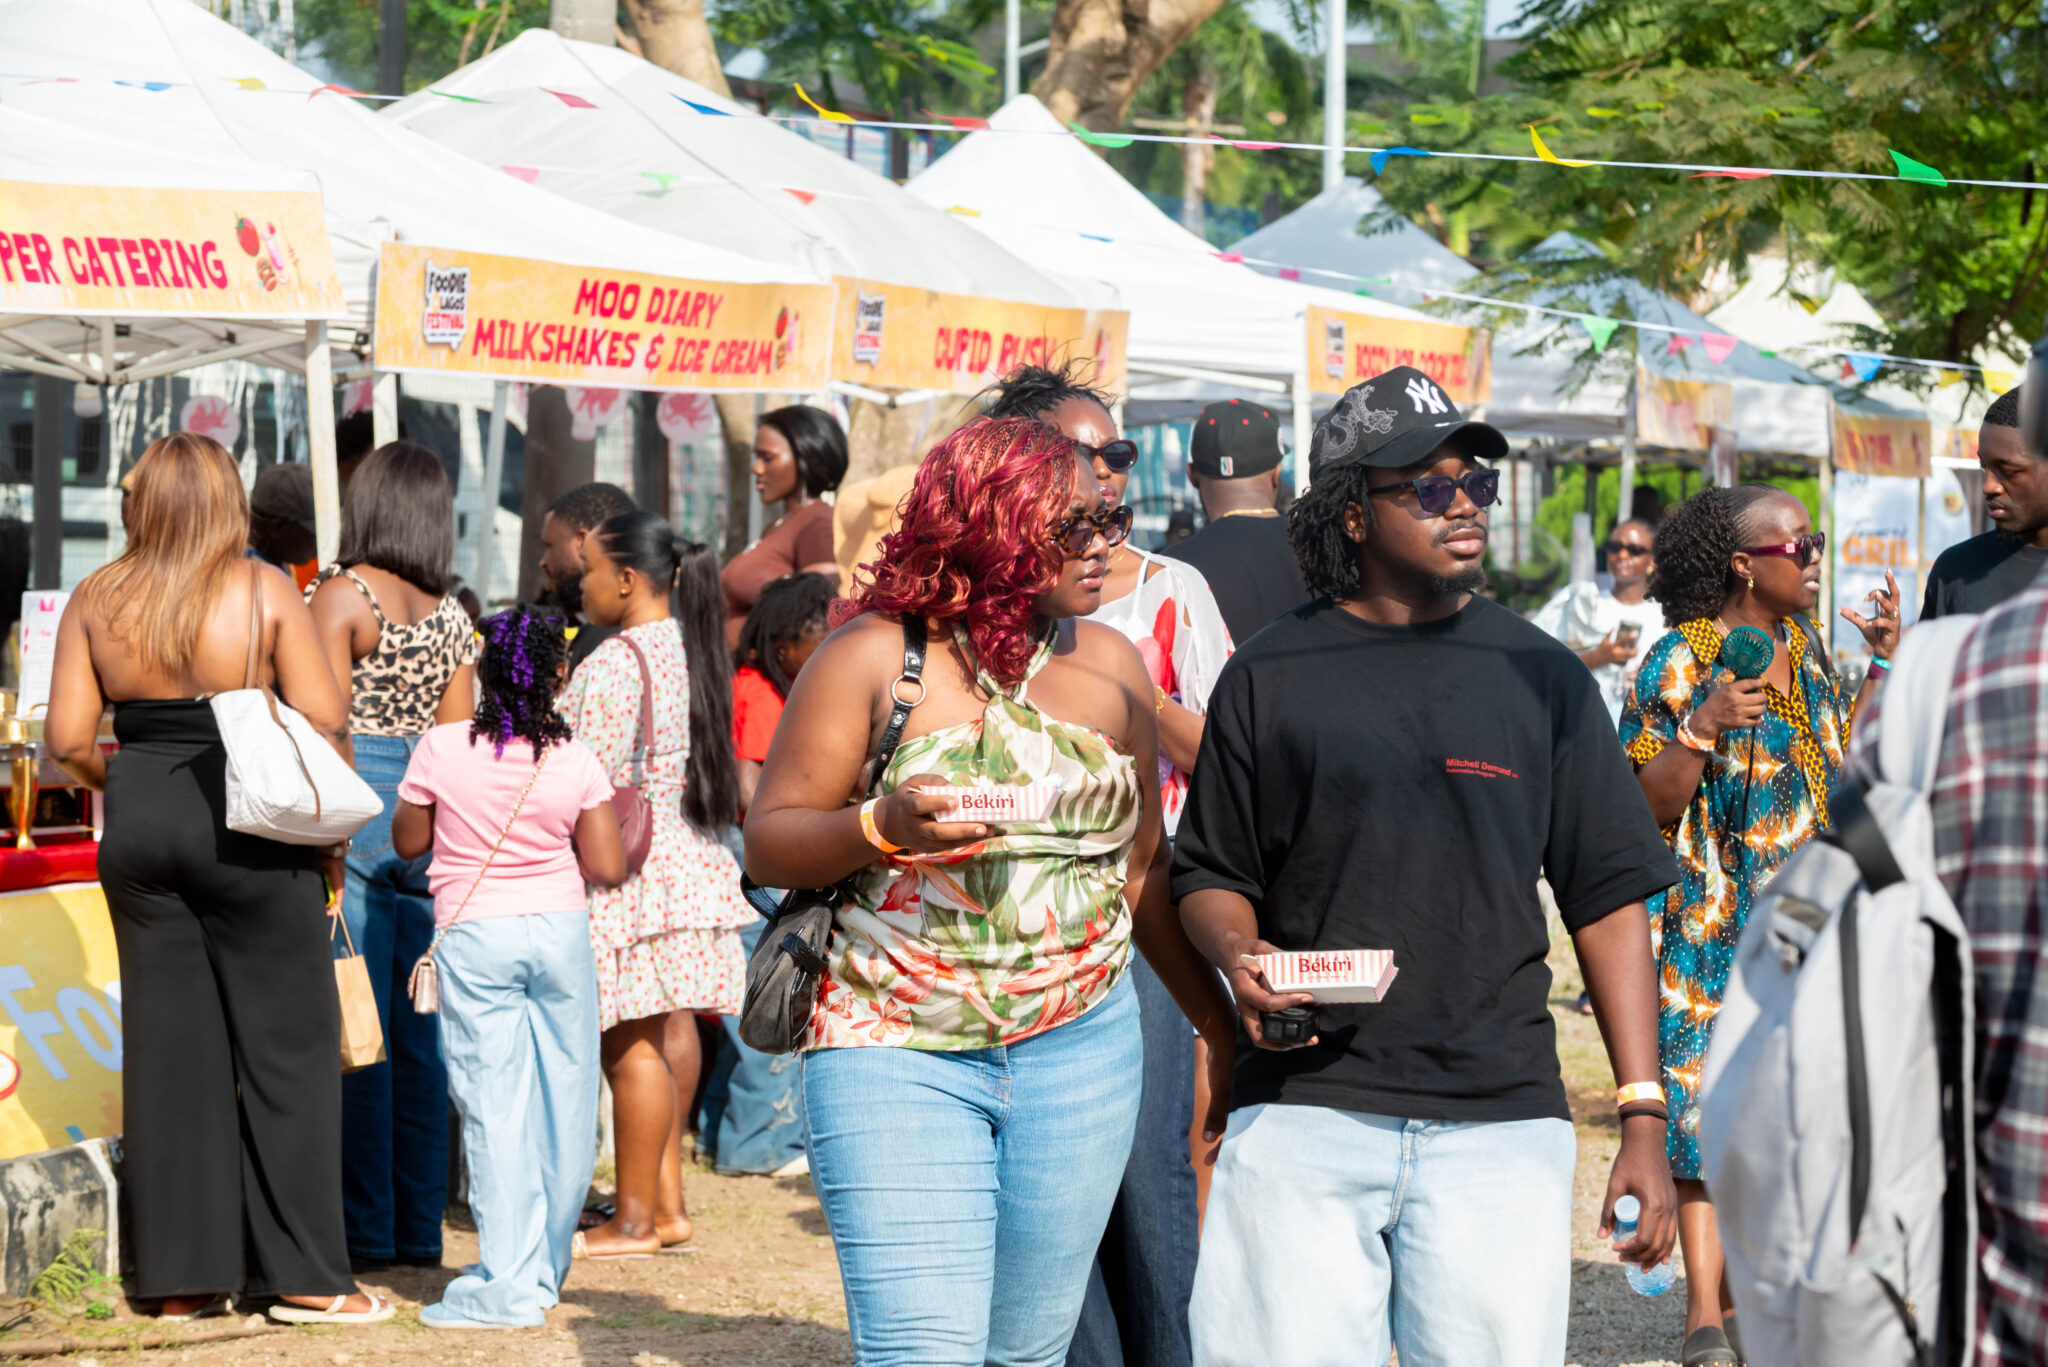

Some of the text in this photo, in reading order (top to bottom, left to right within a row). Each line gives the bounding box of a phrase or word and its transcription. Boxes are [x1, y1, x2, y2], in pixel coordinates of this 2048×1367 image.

[0, 231, 228, 290] PER CATERING
[573, 278, 724, 329] MOO DIARY
[472, 318, 774, 375] MILKSHAKES & ICE CREAM
[934, 326, 991, 373] CUPID
[1405, 378, 1448, 414] NY
[1446, 758, 1480, 769] Mitchell
[1480, 761, 1512, 776] Demand
[962, 793, 1014, 809] Békírì
[1299, 956, 1351, 972] Békírì
